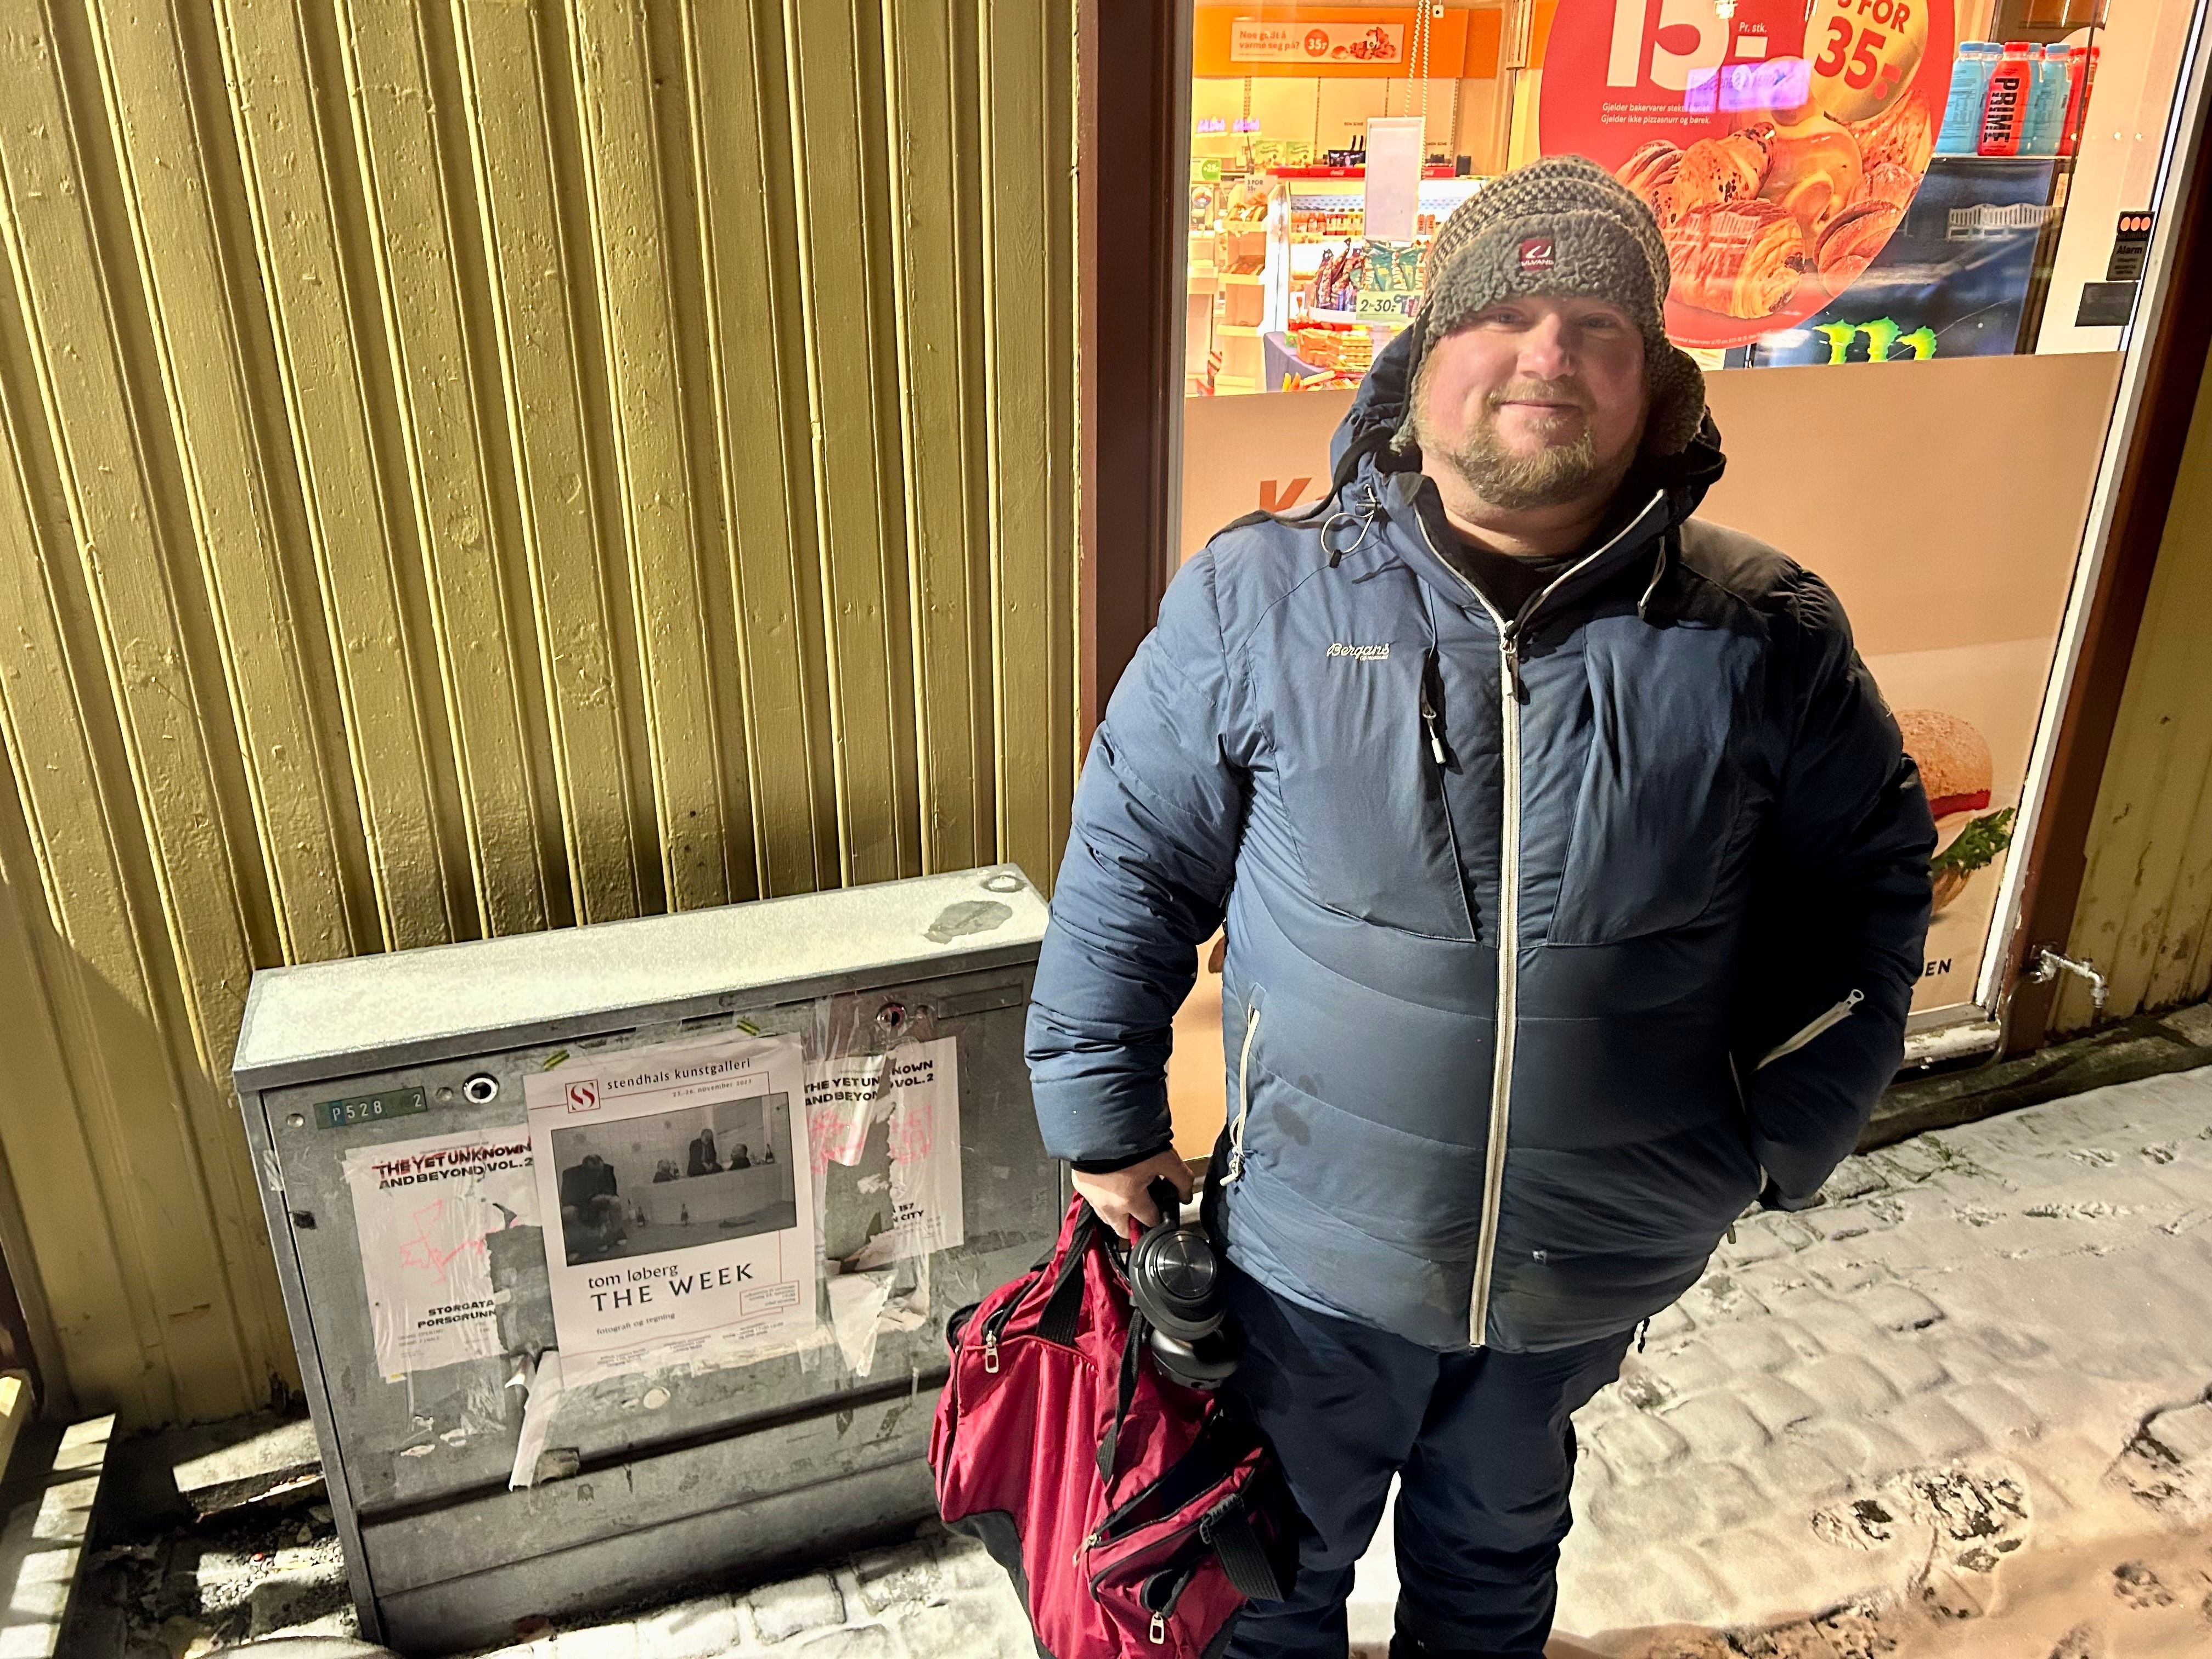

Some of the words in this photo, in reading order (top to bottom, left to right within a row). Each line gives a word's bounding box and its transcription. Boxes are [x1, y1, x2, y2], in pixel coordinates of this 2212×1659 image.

[1739, 21, 1750, 32] Pr.
[1752, 22, 1768, 33] stk.
[1602, 102, 1628, 112] Gjelder
[1629, 103, 1667, 112] bakervarer
[1983, 78, 2020, 143] PRIME
[1601, 114, 1627, 125] Gjelder
[1643, 116, 1679, 125] pizzasnurr
[1679, 117, 1688, 126] og
[2116, 245, 2142, 255] Alarm
[1359, 299, 1369, 312] 2
[1326, 643, 1390, 659] Bergans
[607, 1071, 669, 1090] stendhals
[674, 1058, 751, 1080] kunstgalleri
[697, 1082, 733, 1093] november
[832, 1077, 860, 1087] YET
[413, 1093, 422, 1107] 2
[805, 1093, 833, 1106] AND
[376, 1159, 411, 1179] THE
[412, 1153, 447, 1173] YET
[448, 1143, 532, 1165] UNKNOWN
[379, 1176, 415, 1189] AND
[416, 1165, 484, 1183] BEYOND
[901, 1210, 924, 1221] CITY
[588, 1274, 620, 1289] tom
[627, 1264, 679, 1282] løberg
[590, 1285, 653, 1312] THE
[668, 1263, 753, 1297] WEEK
[428, 1300, 494, 1316] STORGATA
[596, 1322, 631, 1335] fotografi
[646, 1313, 675, 1324] tegning
